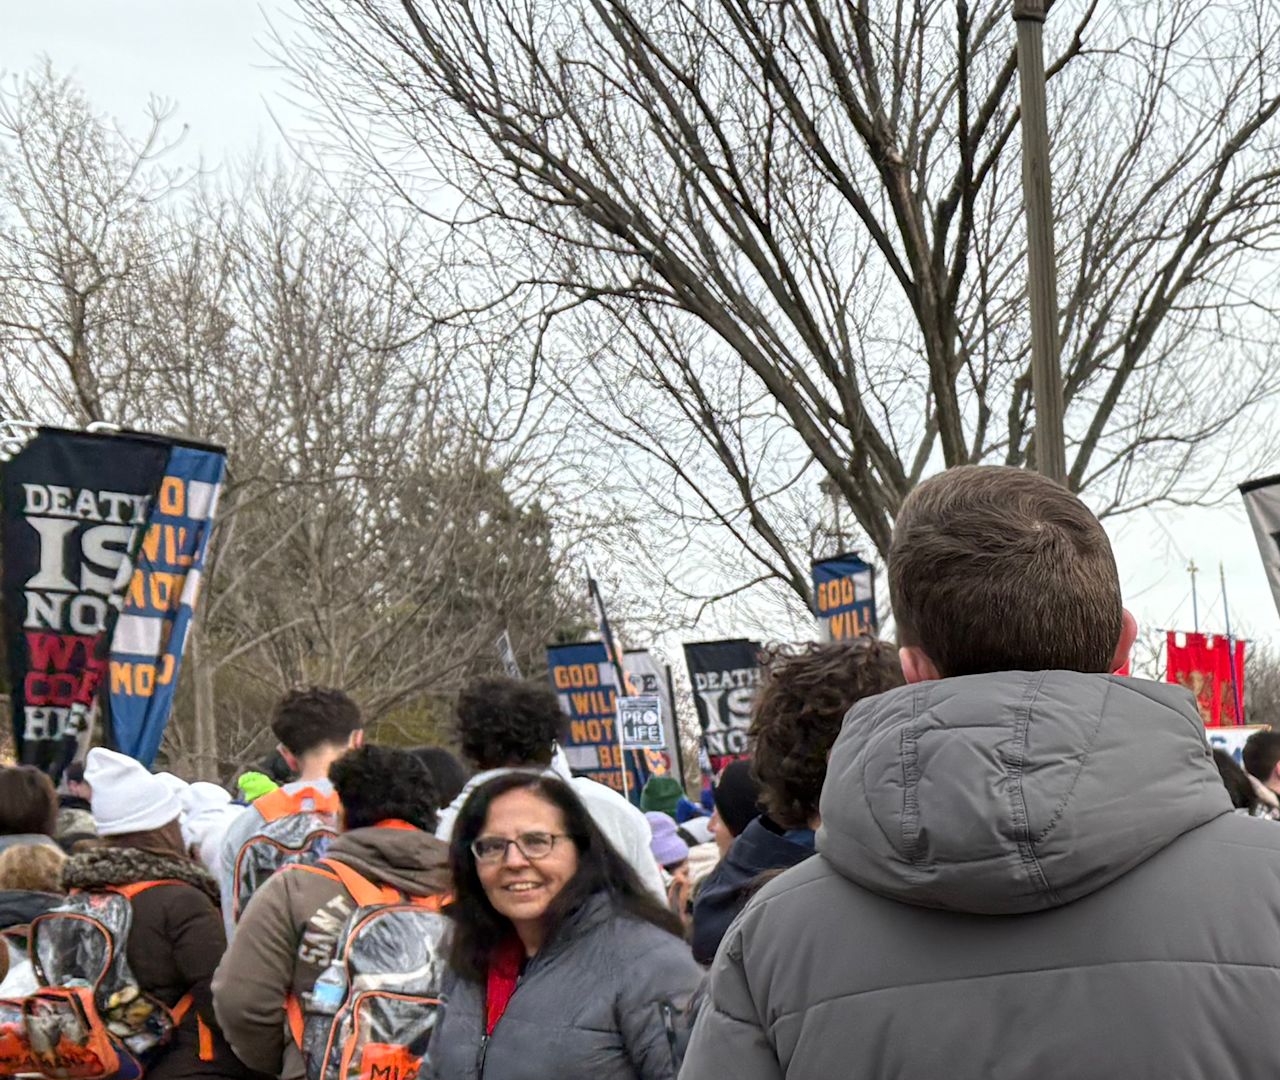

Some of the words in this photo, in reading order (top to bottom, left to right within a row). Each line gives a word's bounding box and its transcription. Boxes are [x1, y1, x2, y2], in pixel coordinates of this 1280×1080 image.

[25, 517, 137, 597] IS
[553, 664, 598, 689] GOD
[622, 710, 657, 726] PRO
[570, 718, 613, 744] NOT
[624, 725, 659, 742] LIFE
